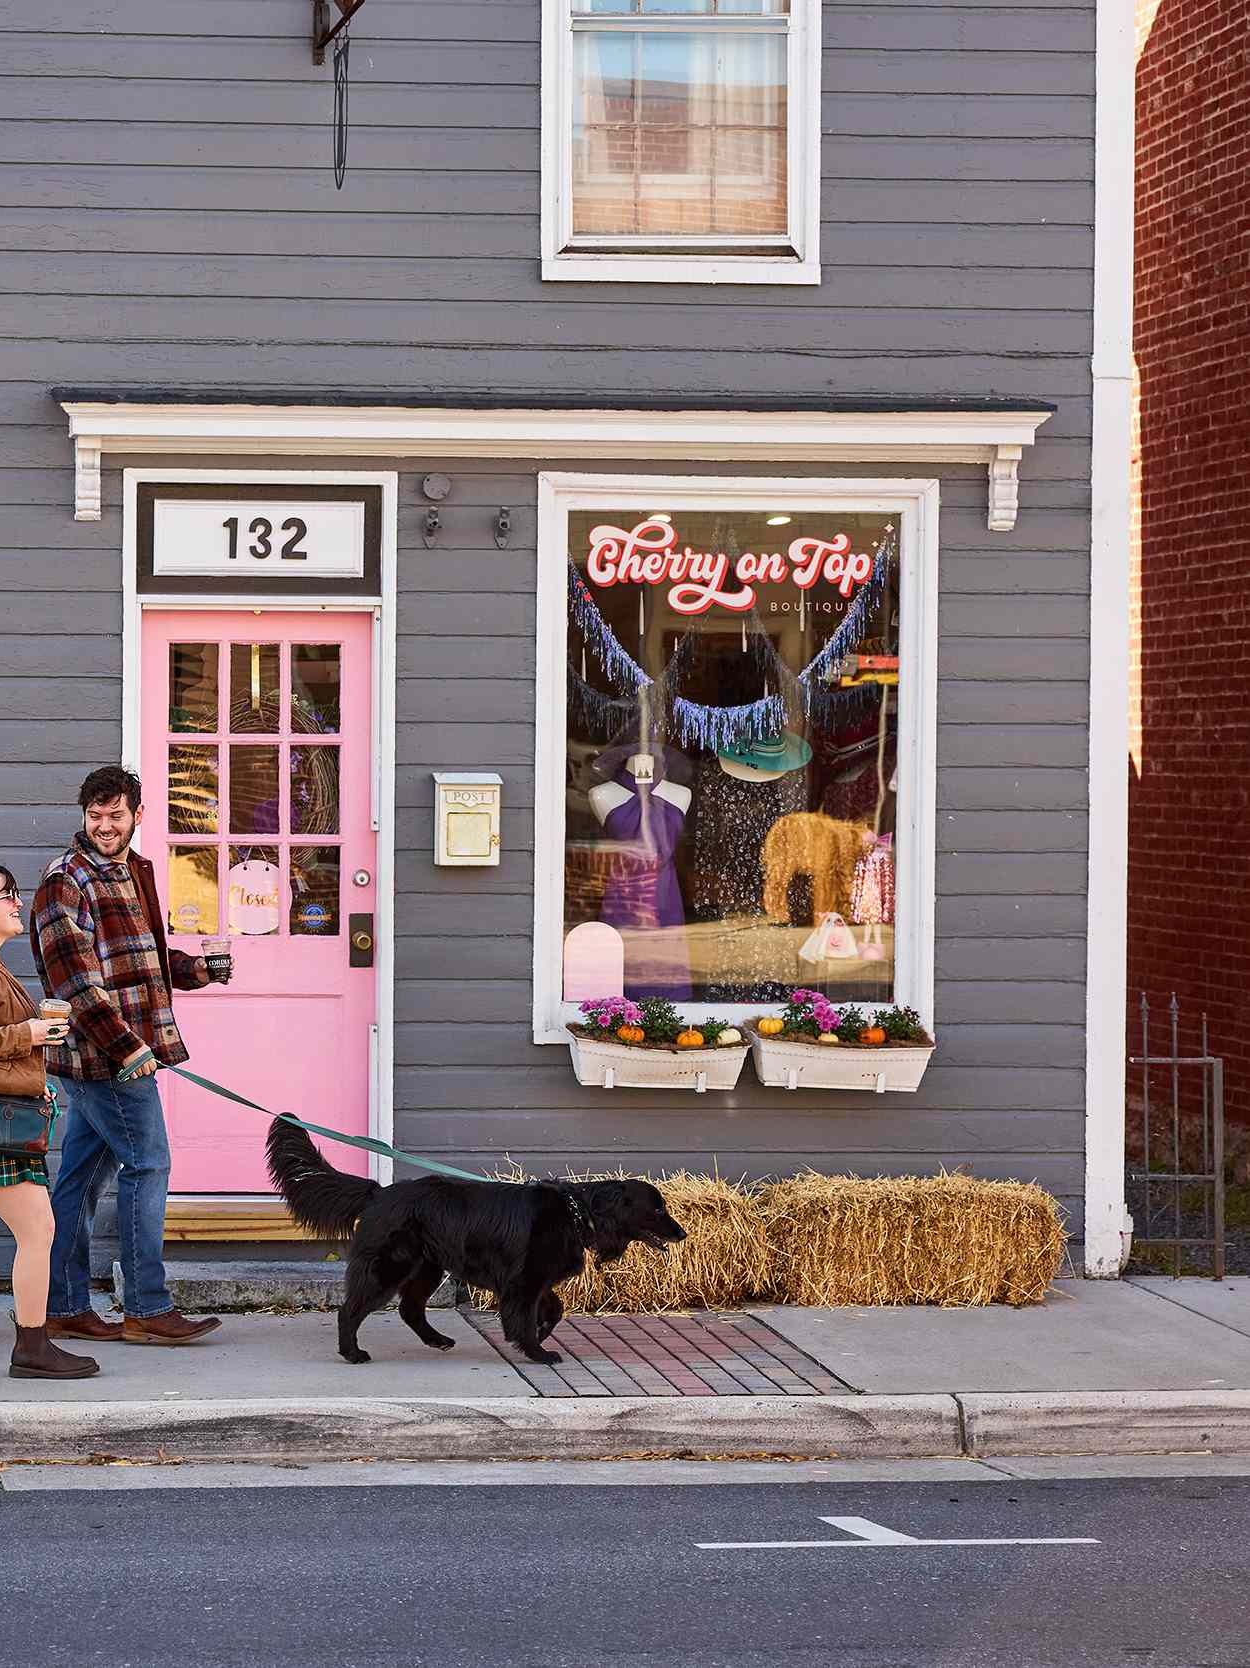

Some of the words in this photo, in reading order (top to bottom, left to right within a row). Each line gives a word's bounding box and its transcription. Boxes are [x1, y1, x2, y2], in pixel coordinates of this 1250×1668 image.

[223, 517, 308, 560] 132
[588, 520, 756, 614] Cherry
[736, 552, 790, 584] on
[788, 534, 873, 598] Top
[453, 791, 486, 801] POST
